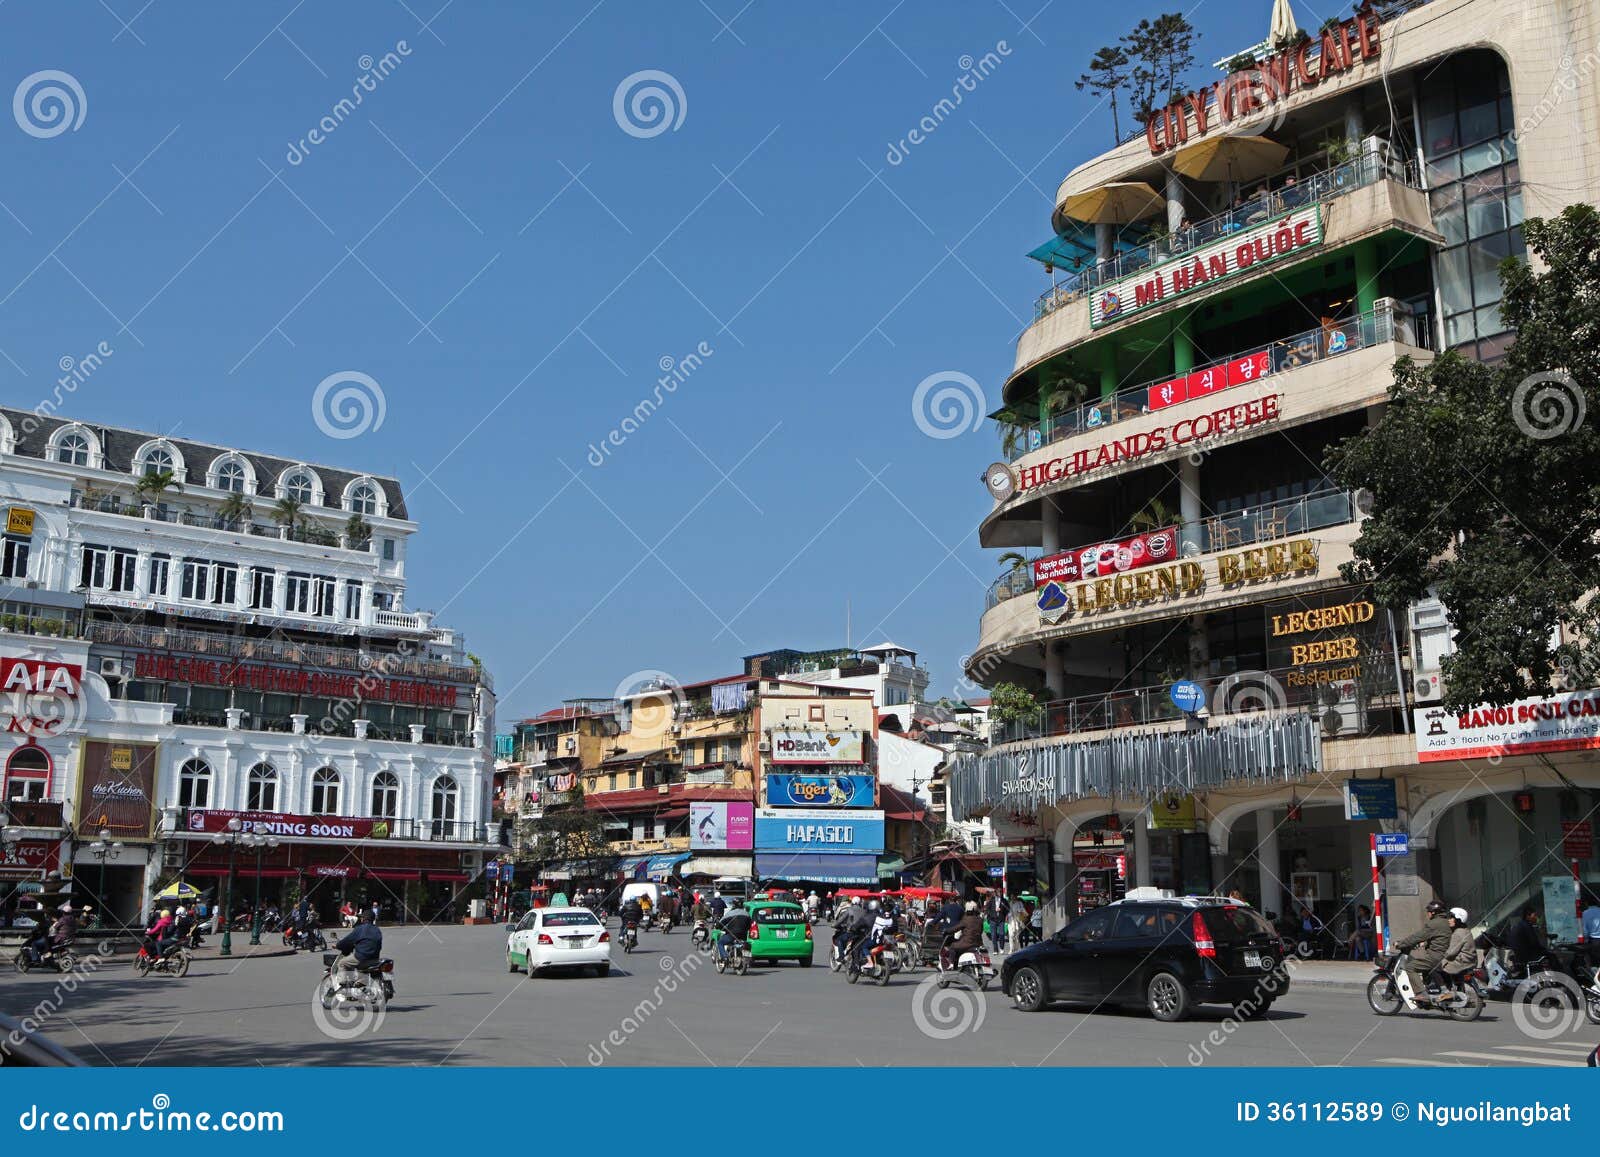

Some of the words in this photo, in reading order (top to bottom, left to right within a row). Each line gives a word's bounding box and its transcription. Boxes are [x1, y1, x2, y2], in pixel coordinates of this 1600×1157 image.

[1146, 87, 1208, 155] CITY
[1213, 49, 1291, 126] VIEW
[1134, 271, 1164, 307] MÌ
[1172, 254, 1227, 294] HÀN
[1236, 214, 1312, 268] QUỐC
[1172, 393, 1280, 444] COFFEE
[1076, 561, 1204, 612] LEGEND
[1216, 539, 1318, 585] BEER
[1271, 600, 1375, 637] LEGEND
[1291, 637, 1360, 666] BEER
[4, 662, 75, 695] AIA
[1287, 663, 1362, 688] Restaurant
[6, 716, 61, 736] KFC
[1458, 705, 1516, 730] HANOI
[1518, 701, 1566, 724] SOUL
[777, 739, 827, 752] HDBank
[793, 782, 828, 800] Tiger
[1002, 775, 1056, 795] SWAROVSKI
[240, 820, 307, 836] PENING
[310, 824, 354, 838] SOON
[786, 824, 854, 844] HAFASCO
[19, 847, 46, 856] KFC
